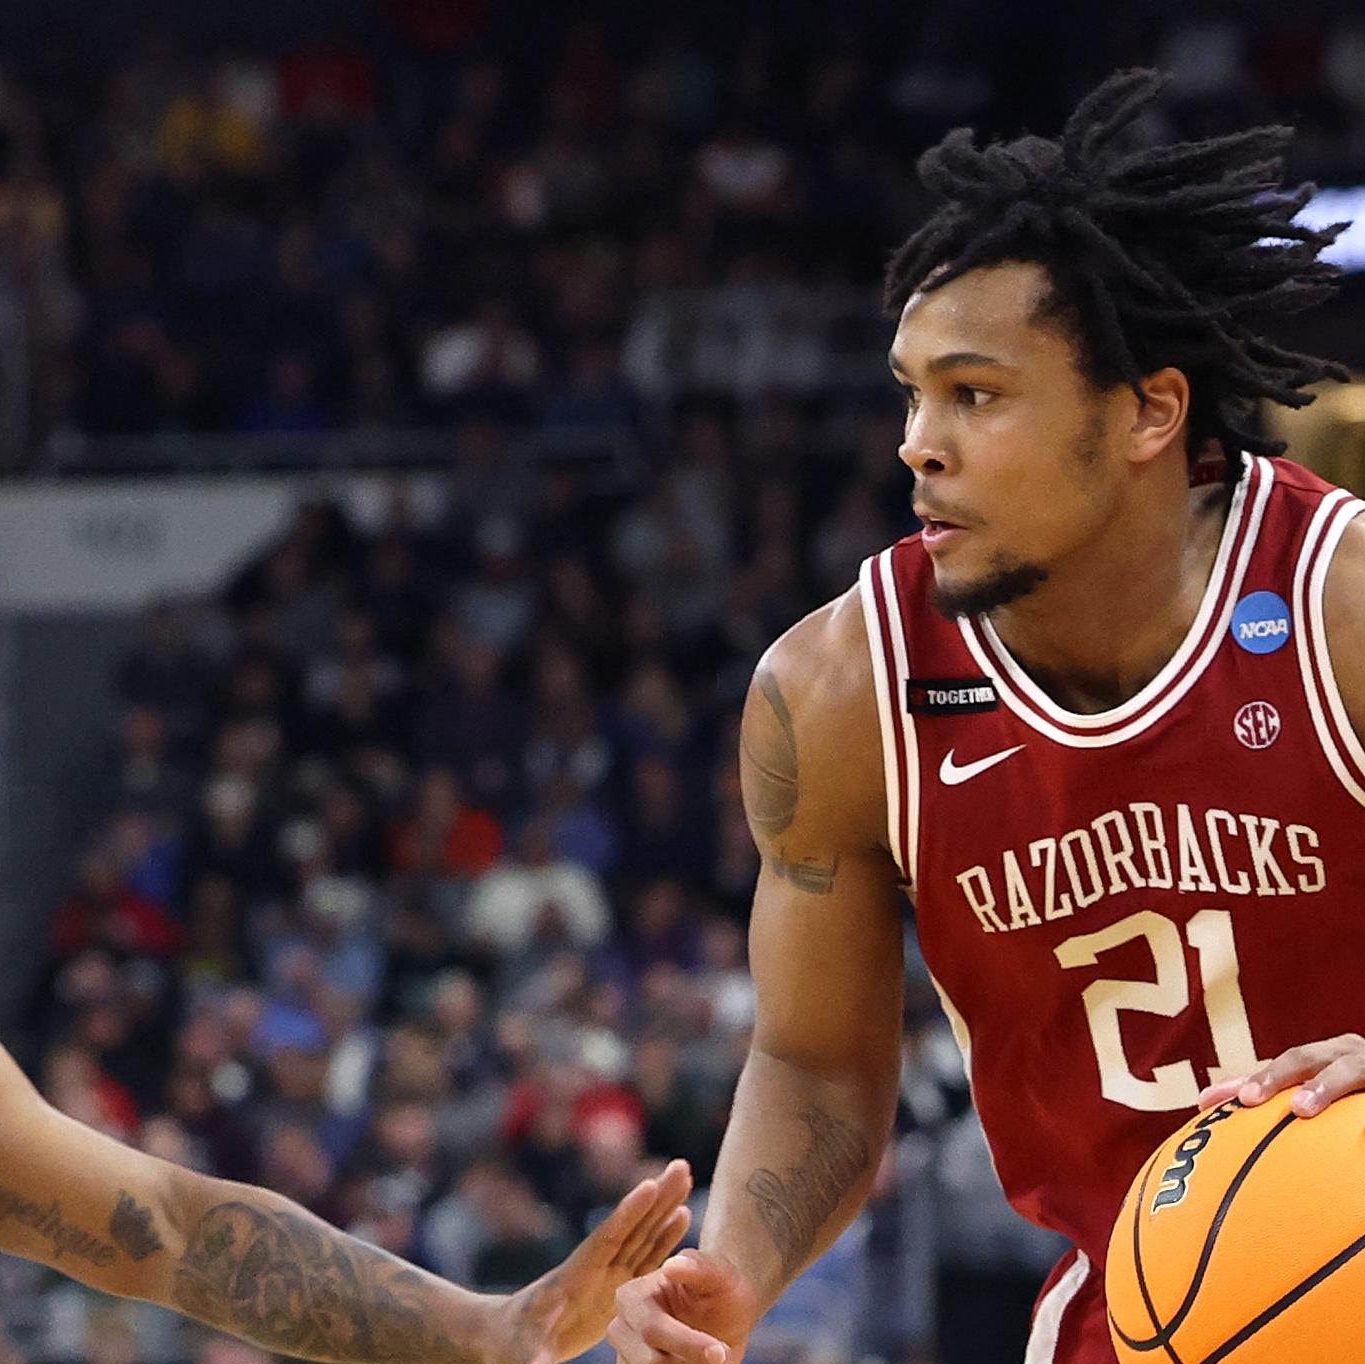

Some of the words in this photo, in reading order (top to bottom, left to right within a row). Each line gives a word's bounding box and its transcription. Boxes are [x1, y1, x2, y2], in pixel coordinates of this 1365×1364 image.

[1239, 618, 1289, 639] NCAA
[1236, 702, 1279, 748] SEC
[955, 802, 1327, 933] RAZORBACKS
[1052, 908, 1276, 1112] 21
